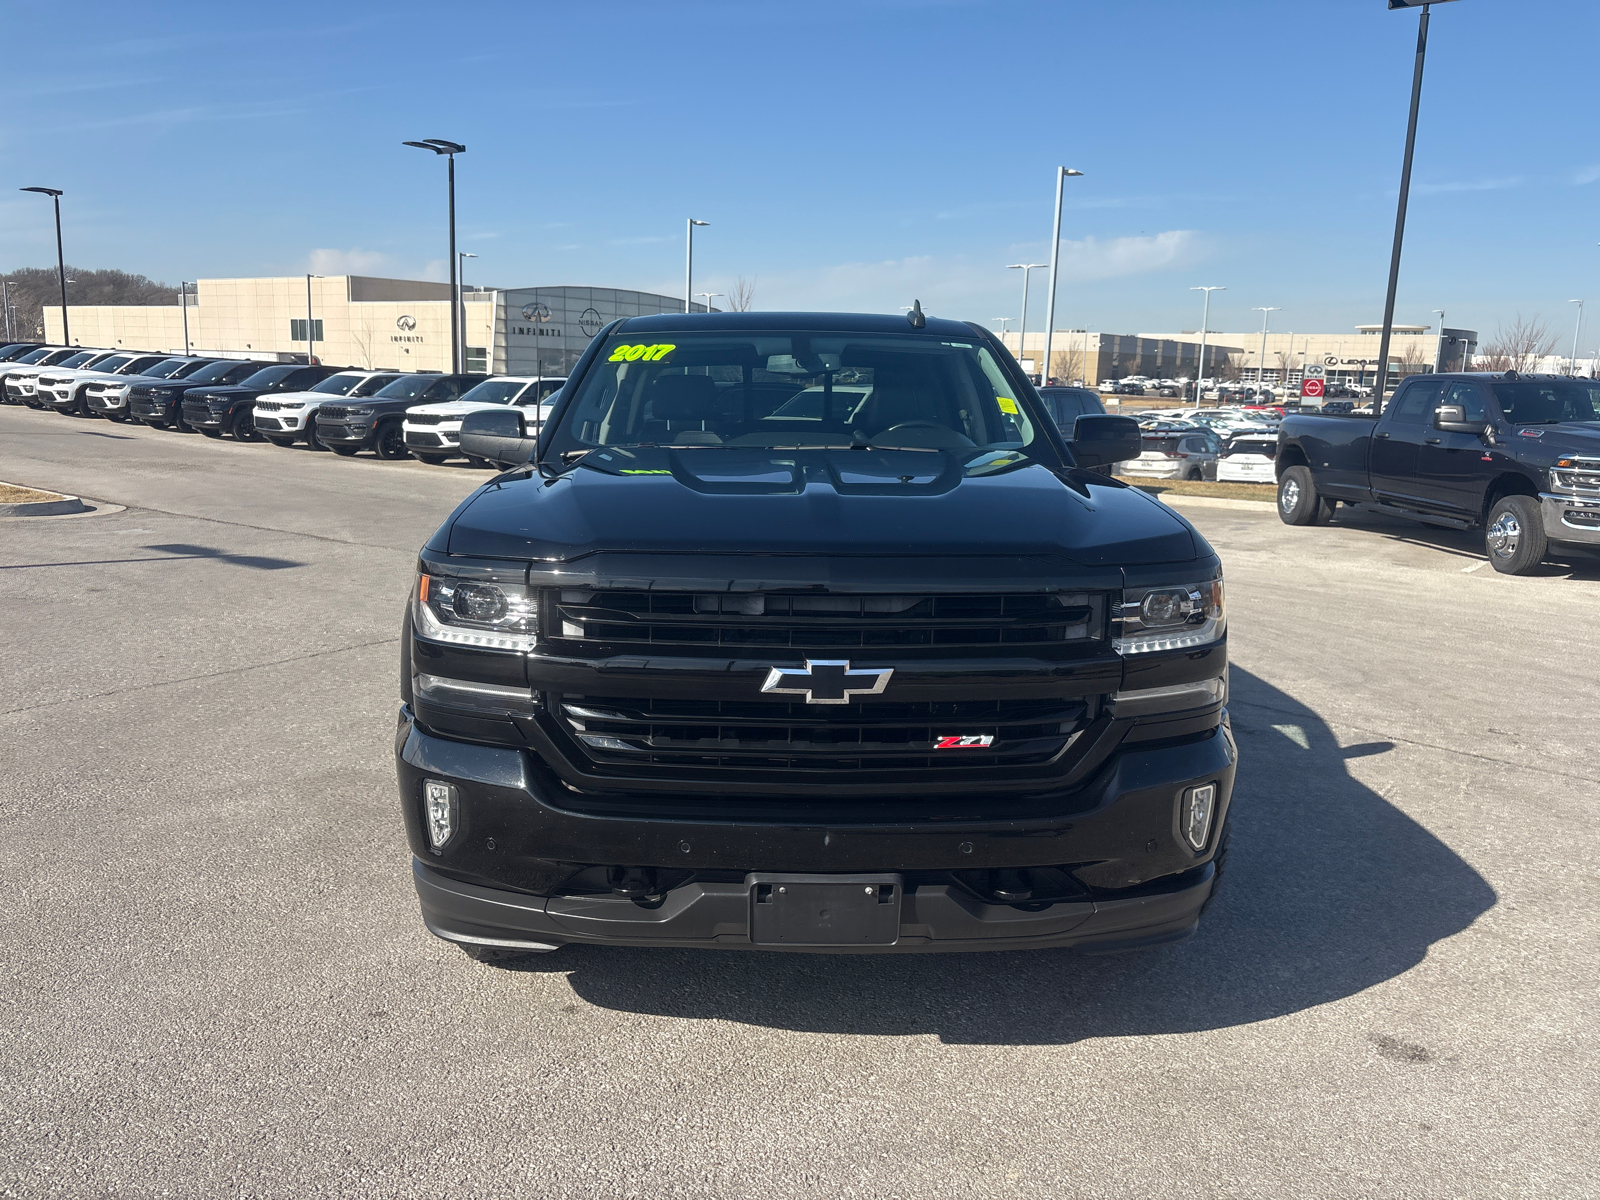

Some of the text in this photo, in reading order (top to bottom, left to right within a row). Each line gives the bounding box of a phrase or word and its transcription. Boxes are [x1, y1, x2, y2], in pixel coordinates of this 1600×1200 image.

[512, 327, 560, 336] INFINITI
[390, 335, 424, 343] INFINITI
[608, 344, 676, 362] 2017
[933, 735, 994, 748] Z71
